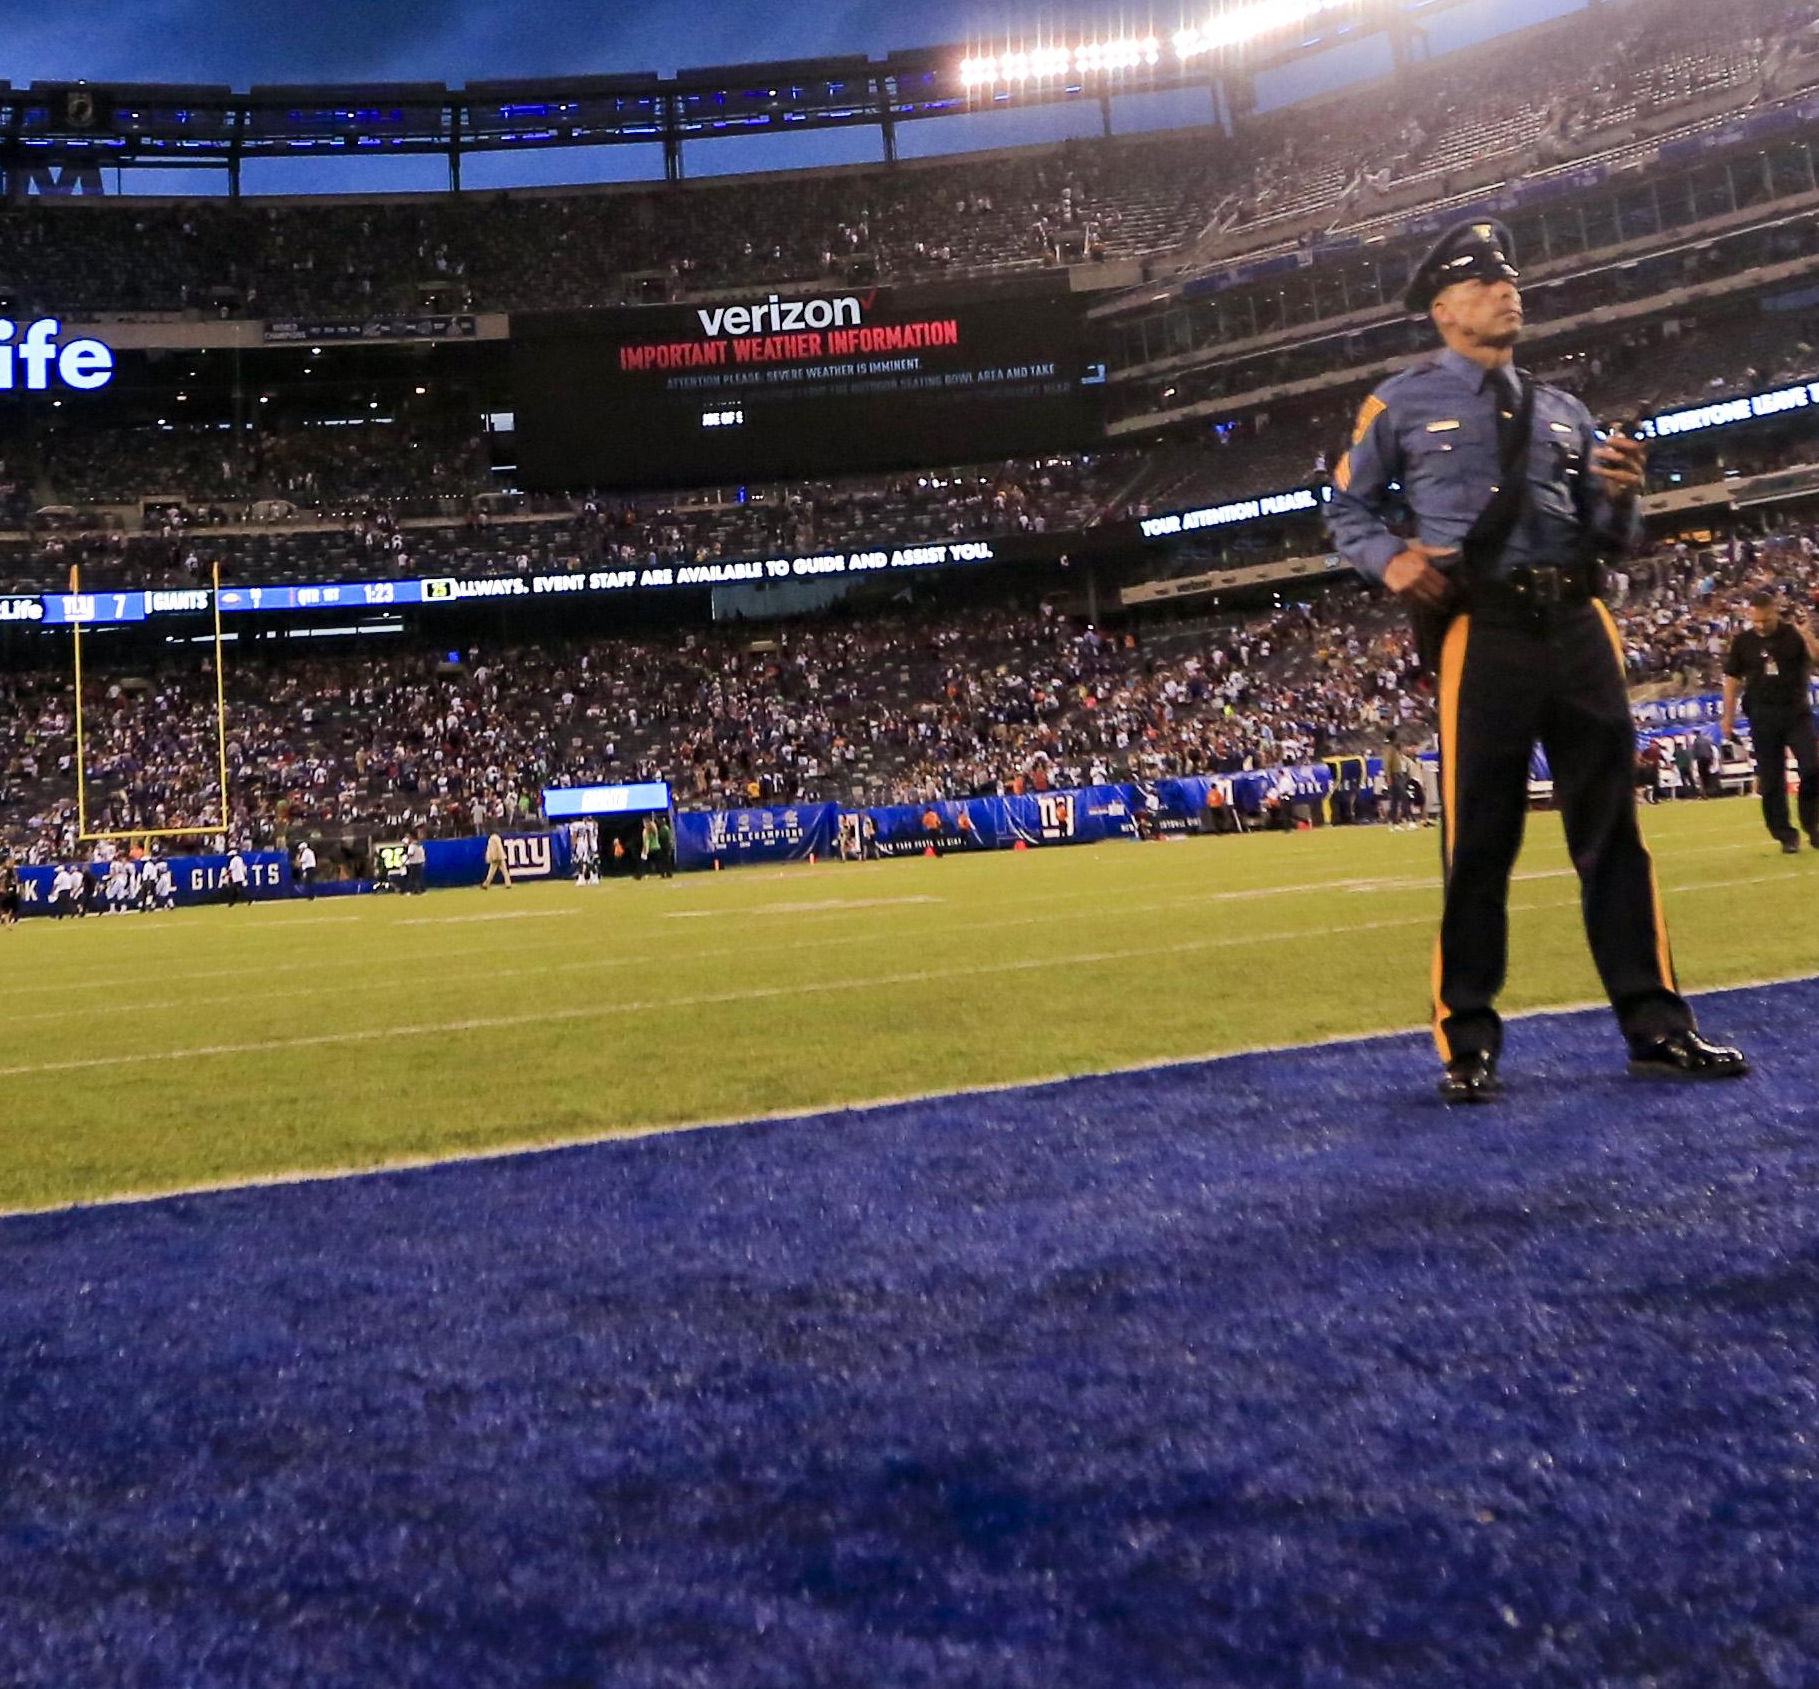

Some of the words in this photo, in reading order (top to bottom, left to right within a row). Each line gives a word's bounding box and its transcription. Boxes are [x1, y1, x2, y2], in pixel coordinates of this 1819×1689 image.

[698, 293, 861, 337] verizon
[620, 339, 727, 371] IMPORTANT
[733, 333, 821, 362] WEATHER
[828, 320, 958, 355] INFORMATION
[766, 368, 803, 382] SEVERE
[807, 363, 854, 379] WEATHER
[857, 363, 867, 375] IS
[1656, 398, 1752, 437] EVERYONE
[1752, 385, 1808, 417] LEAVE
[1140, 514, 1182, 537] YOUR
[1182, 499, 1260, 530] ATTENTION
[1261, 488, 1318, 517] PLEASE.
[533, 574, 584, 594] EVENT
[589, 569, 637, 590] STAFF
[640, 567, 673, 587] ARE
[676, 560, 763, 584] AVAILABLE
[766, 558, 790, 578] TO
[793, 554, 846, 576] GUIDE
[848, 551, 888, 572] AND
[890, 546, 948, 568] ASSIST
[949, 542, 993, 562] YOU.
[152, 590, 209, 612] GIANTS
[363, 583, 394, 604] 1:23
[431, 582, 448, 597] 25
[112, 594, 126, 619] 7
[748, 827, 804, 841] CHAMPIONS
[190, 862, 281, 891] GIATS
